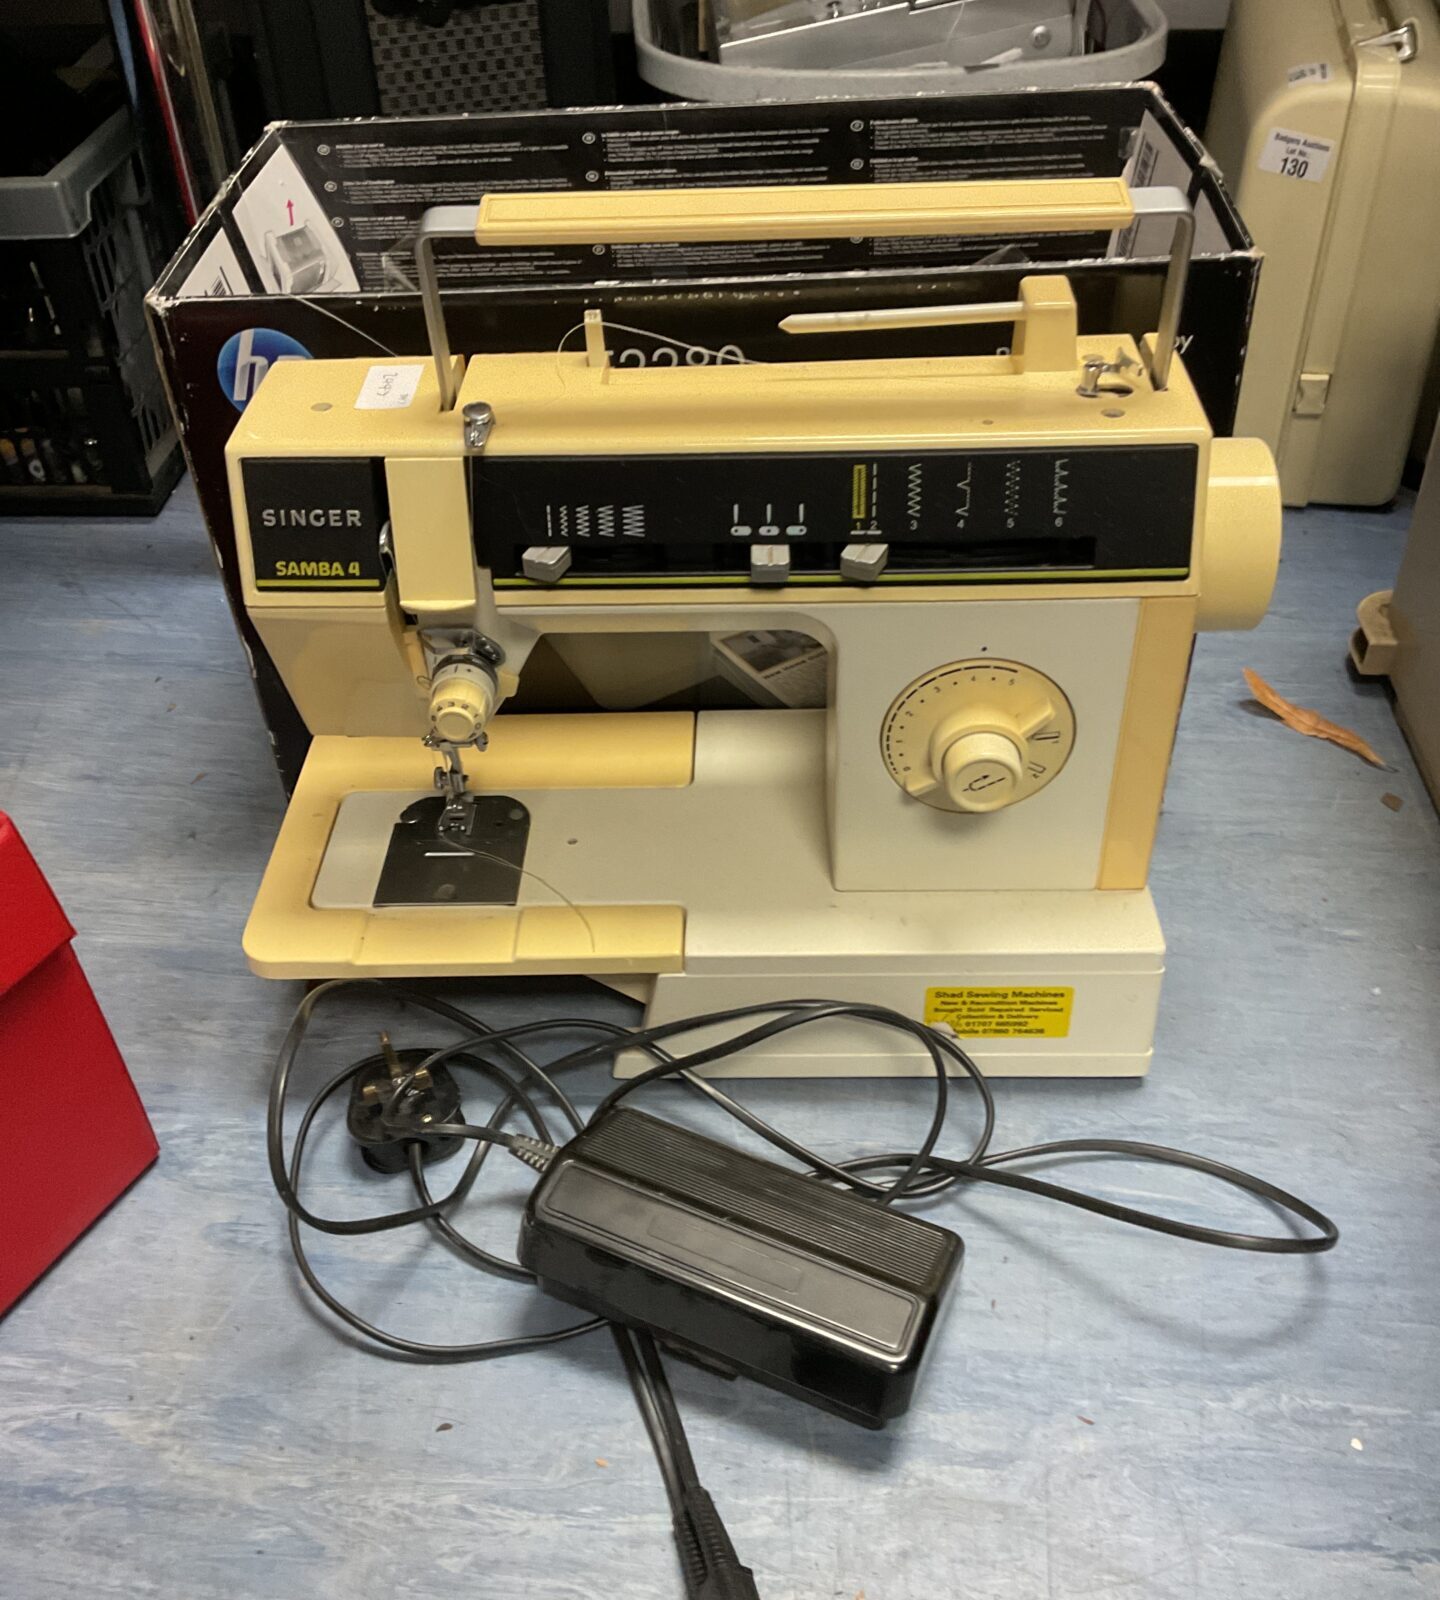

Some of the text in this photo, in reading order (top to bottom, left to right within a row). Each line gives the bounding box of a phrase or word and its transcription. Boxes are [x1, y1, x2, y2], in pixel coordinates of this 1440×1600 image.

[1280, 156, 1308, 178] 130
[261, 508, 362, 527] SINGER
[855, 517, 1063, 530] 1 2 3 4 5 6
[275, 560, 360, 576] SAMBA 4
[966, 991, 1008, 999] Sewing
